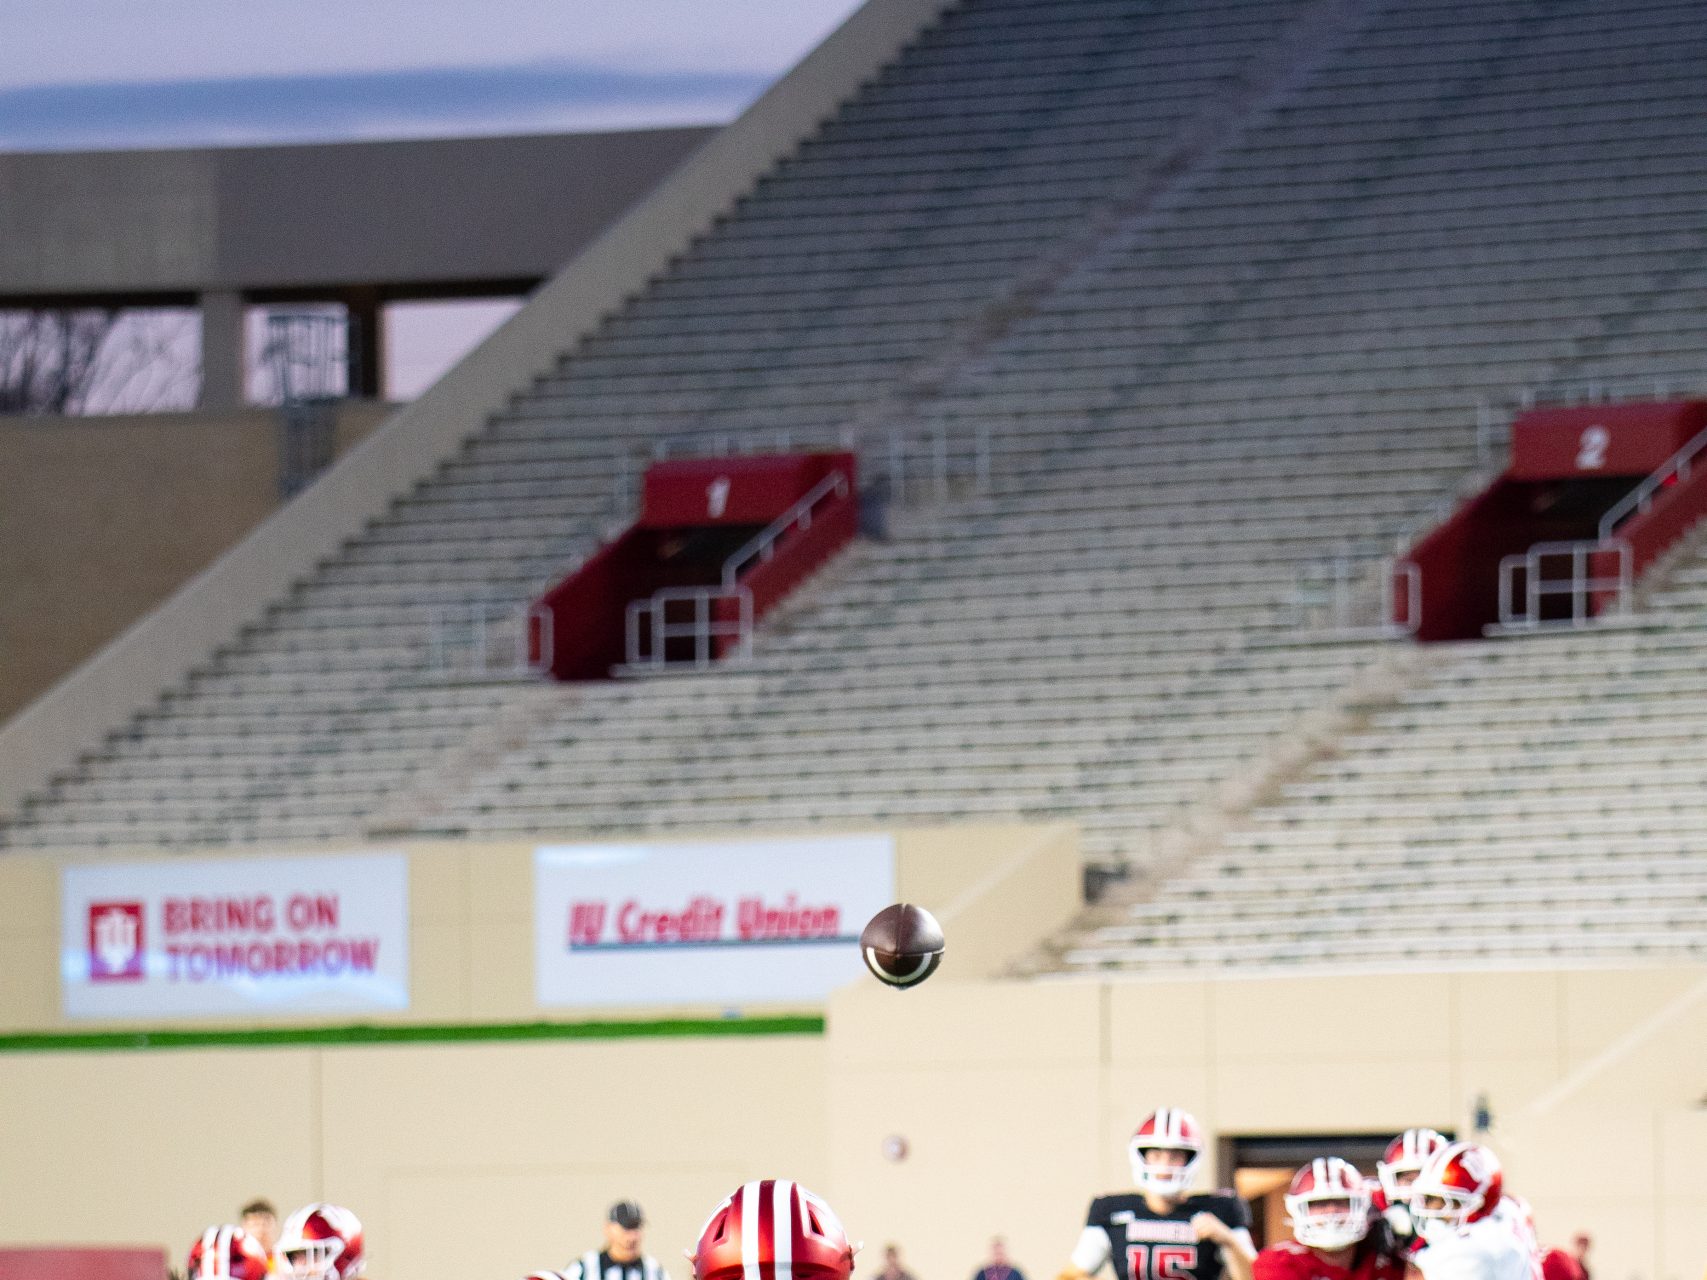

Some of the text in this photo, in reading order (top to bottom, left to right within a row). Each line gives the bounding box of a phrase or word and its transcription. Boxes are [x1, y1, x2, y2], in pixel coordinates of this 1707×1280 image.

[1576, 424, 1610, 471] 2
[707, 476, 732, 519] 1
[162, 893, 341, 934] BRING ON
[617, 896, 725, 944] Credit
[737, 892, 839, 940] Union
[162, 938, 380, 983] TOMORROW
